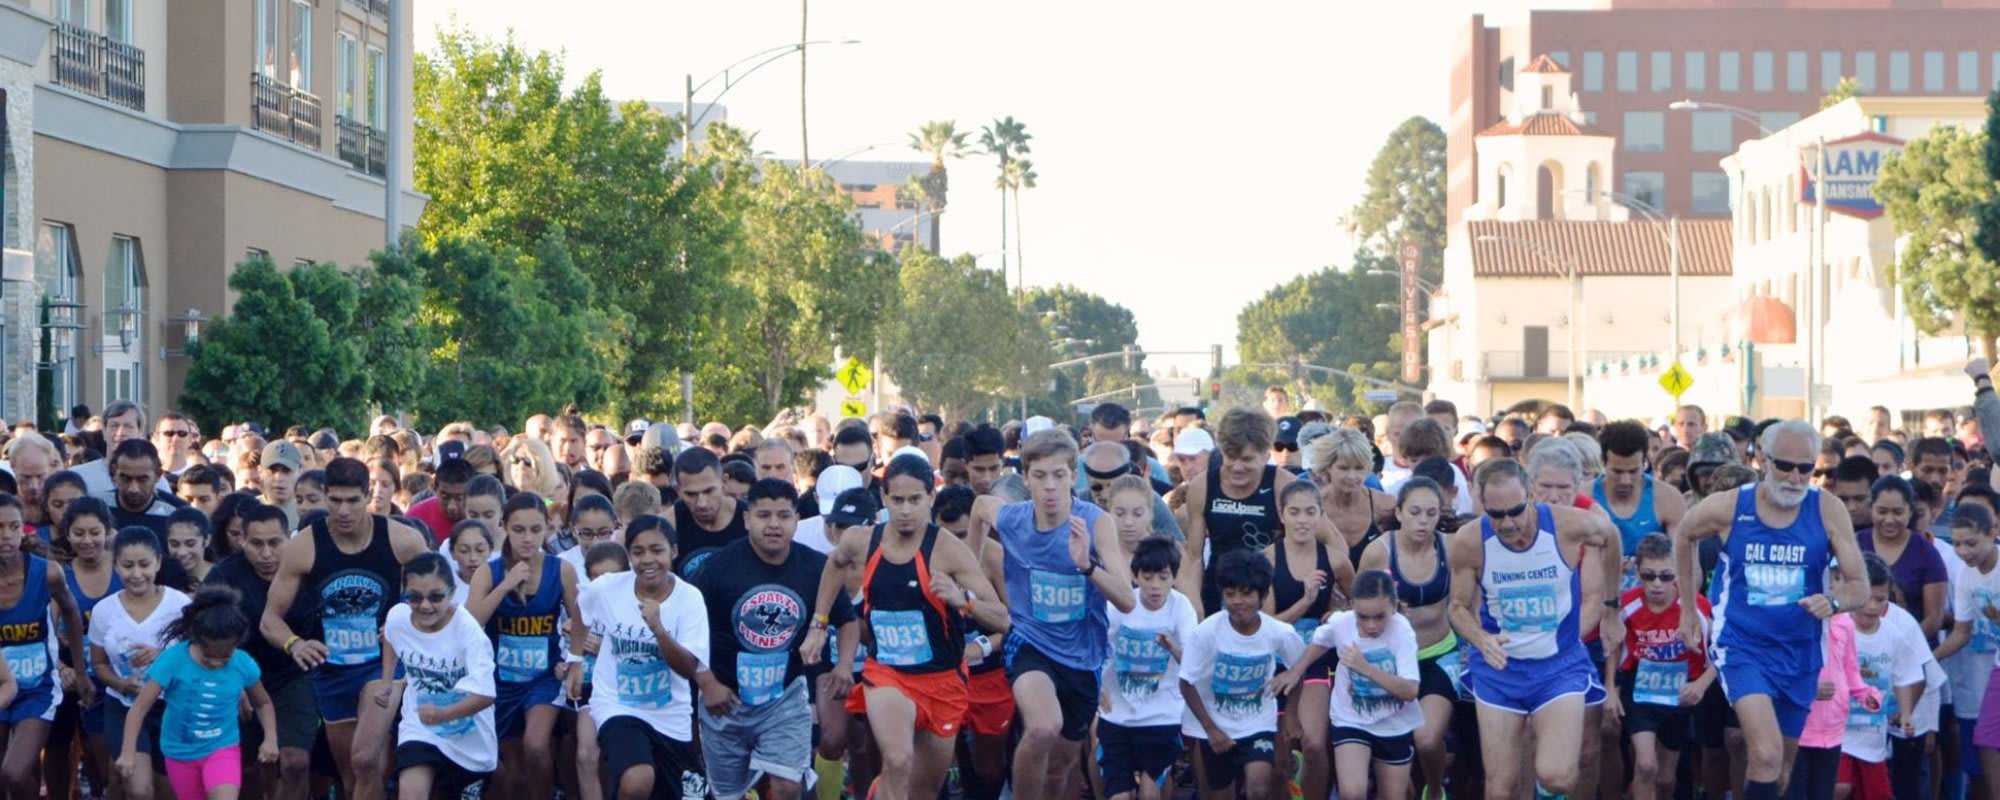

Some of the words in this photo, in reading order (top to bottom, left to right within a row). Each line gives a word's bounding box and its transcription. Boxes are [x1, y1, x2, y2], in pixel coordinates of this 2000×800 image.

[1812, 149, 1882, 176] AAM
[1405, 259, 1417, 378] RIVERSIDE
[1745, 543, 1766, 564] CAL
[1769, 544, 1806, 565] COAST
[1492, 570, 1526, 584] RUNNING
[1526, 565, 1559, 580] CENTER
[740, 590, 800, 618] ESPARZA
[1031, 583, 1084, 607] 3305
[1502, 596, 1555, 618] 2930
[0, 622, 39, 642] ONS
[498, 614, 554, 636] LIONS
[738, 620, 797, 649] FITNESS
[874, 624, 926, 648] 3033
[325, 629, 376, 650] 2090
[498, 646, 547, 671] 2192
[618, 669, 669, 696] 2172
